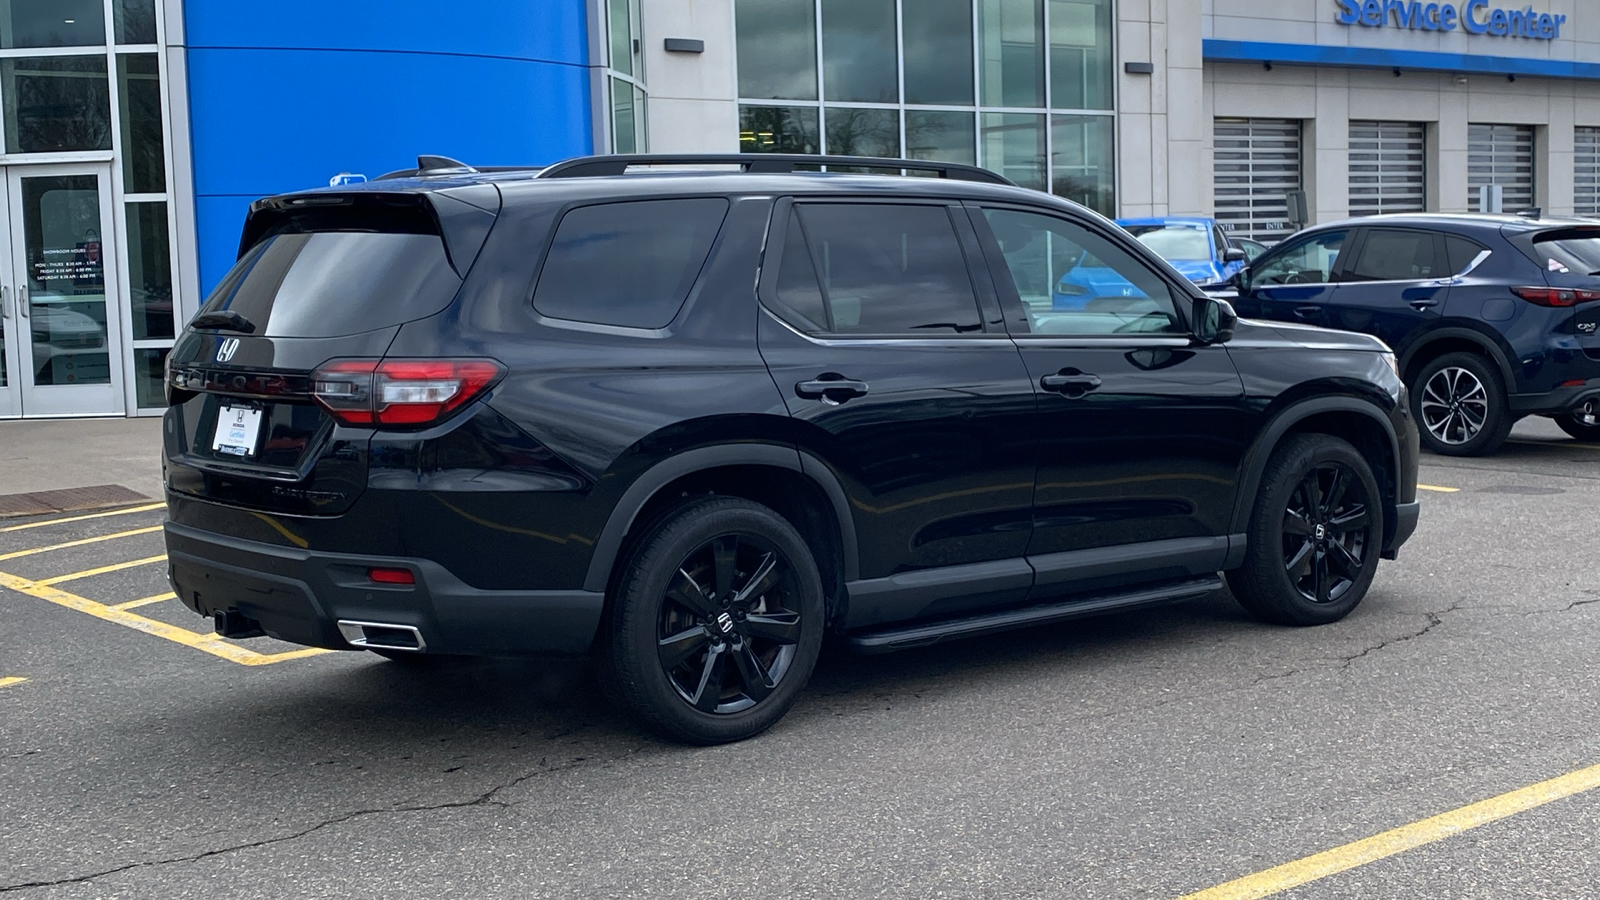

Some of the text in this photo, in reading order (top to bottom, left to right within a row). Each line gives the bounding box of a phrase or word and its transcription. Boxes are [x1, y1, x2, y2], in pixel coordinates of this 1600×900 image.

[1335, 0, 1566, 39] Service Center
[184, 372, 271, 392] PILOT
